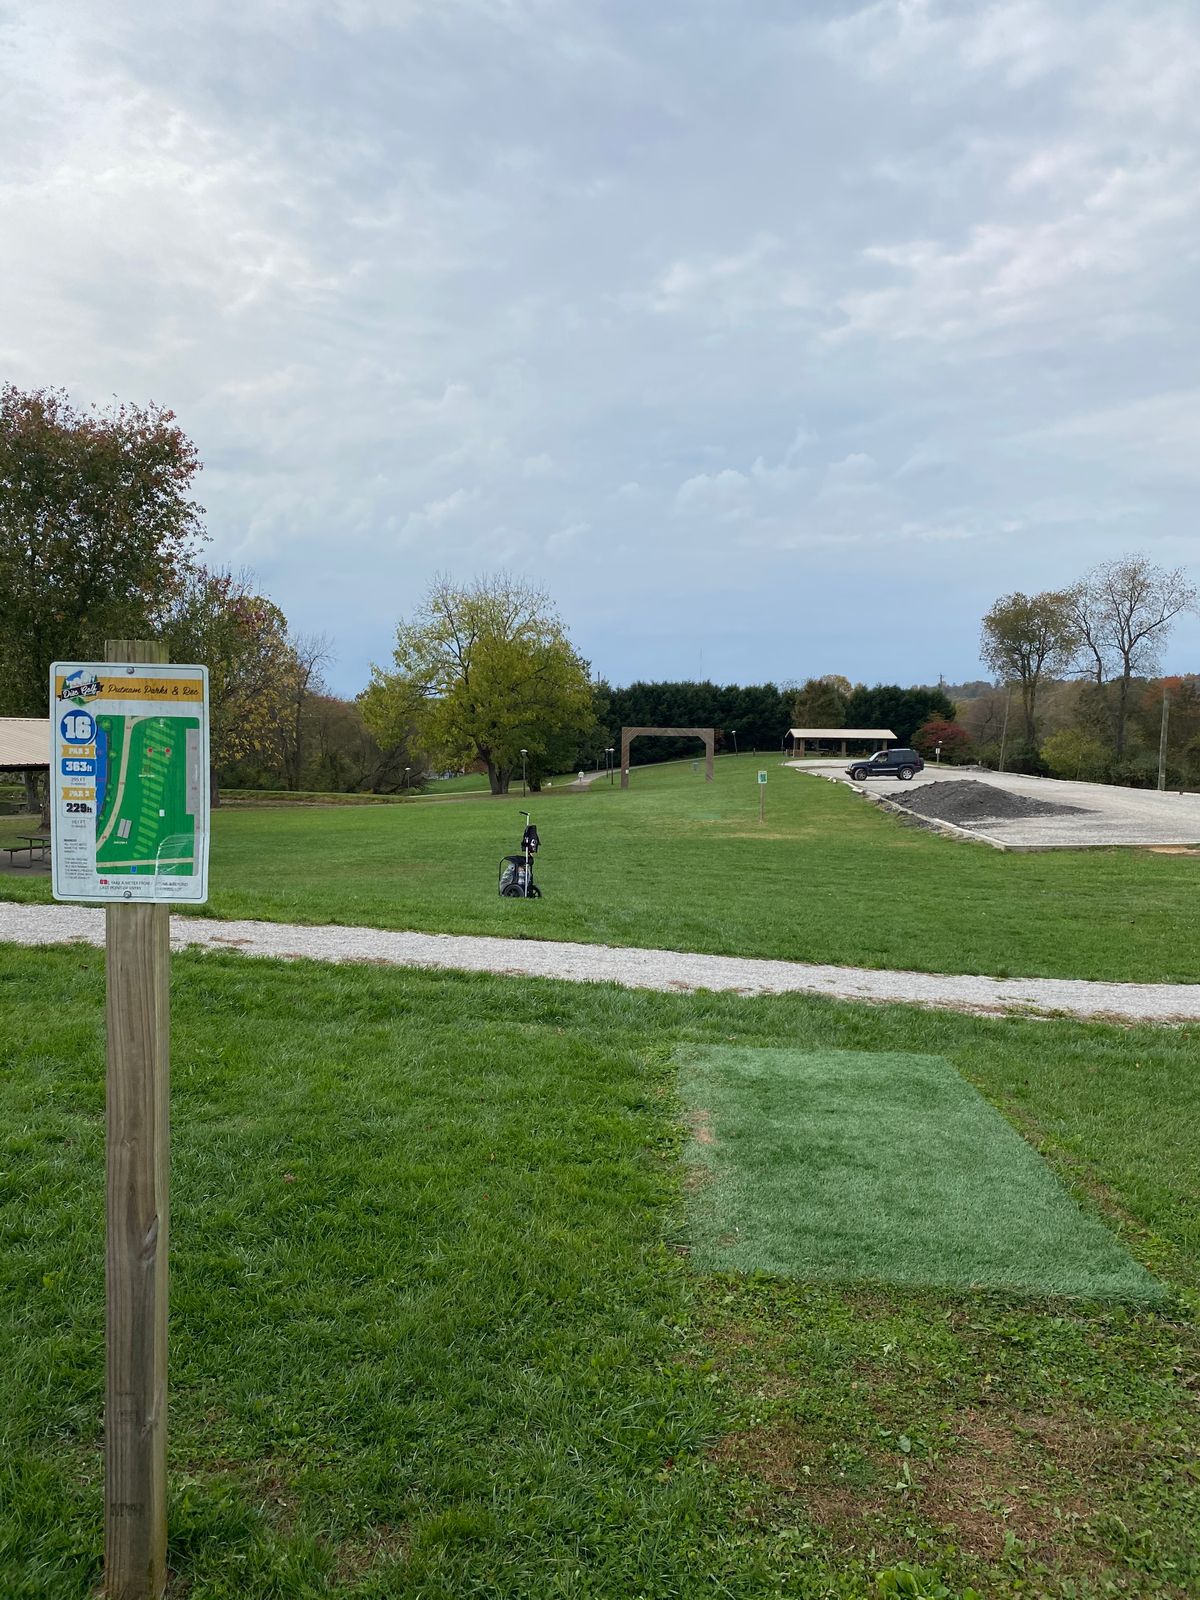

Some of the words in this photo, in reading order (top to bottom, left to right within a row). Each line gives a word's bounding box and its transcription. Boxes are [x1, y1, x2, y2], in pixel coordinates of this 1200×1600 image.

[81, 684, 97, 696] Golf
[108, 684, 141, 694] Putnam
[144, 686, 168, 695] Parks
[172, 686, 179, 696] &
[183, 687, 199, 696] Rec
[64, 715, 91, 739] 16
[68, 747, 83, 755] PAR
[69, 790, 83, 798] PAR
